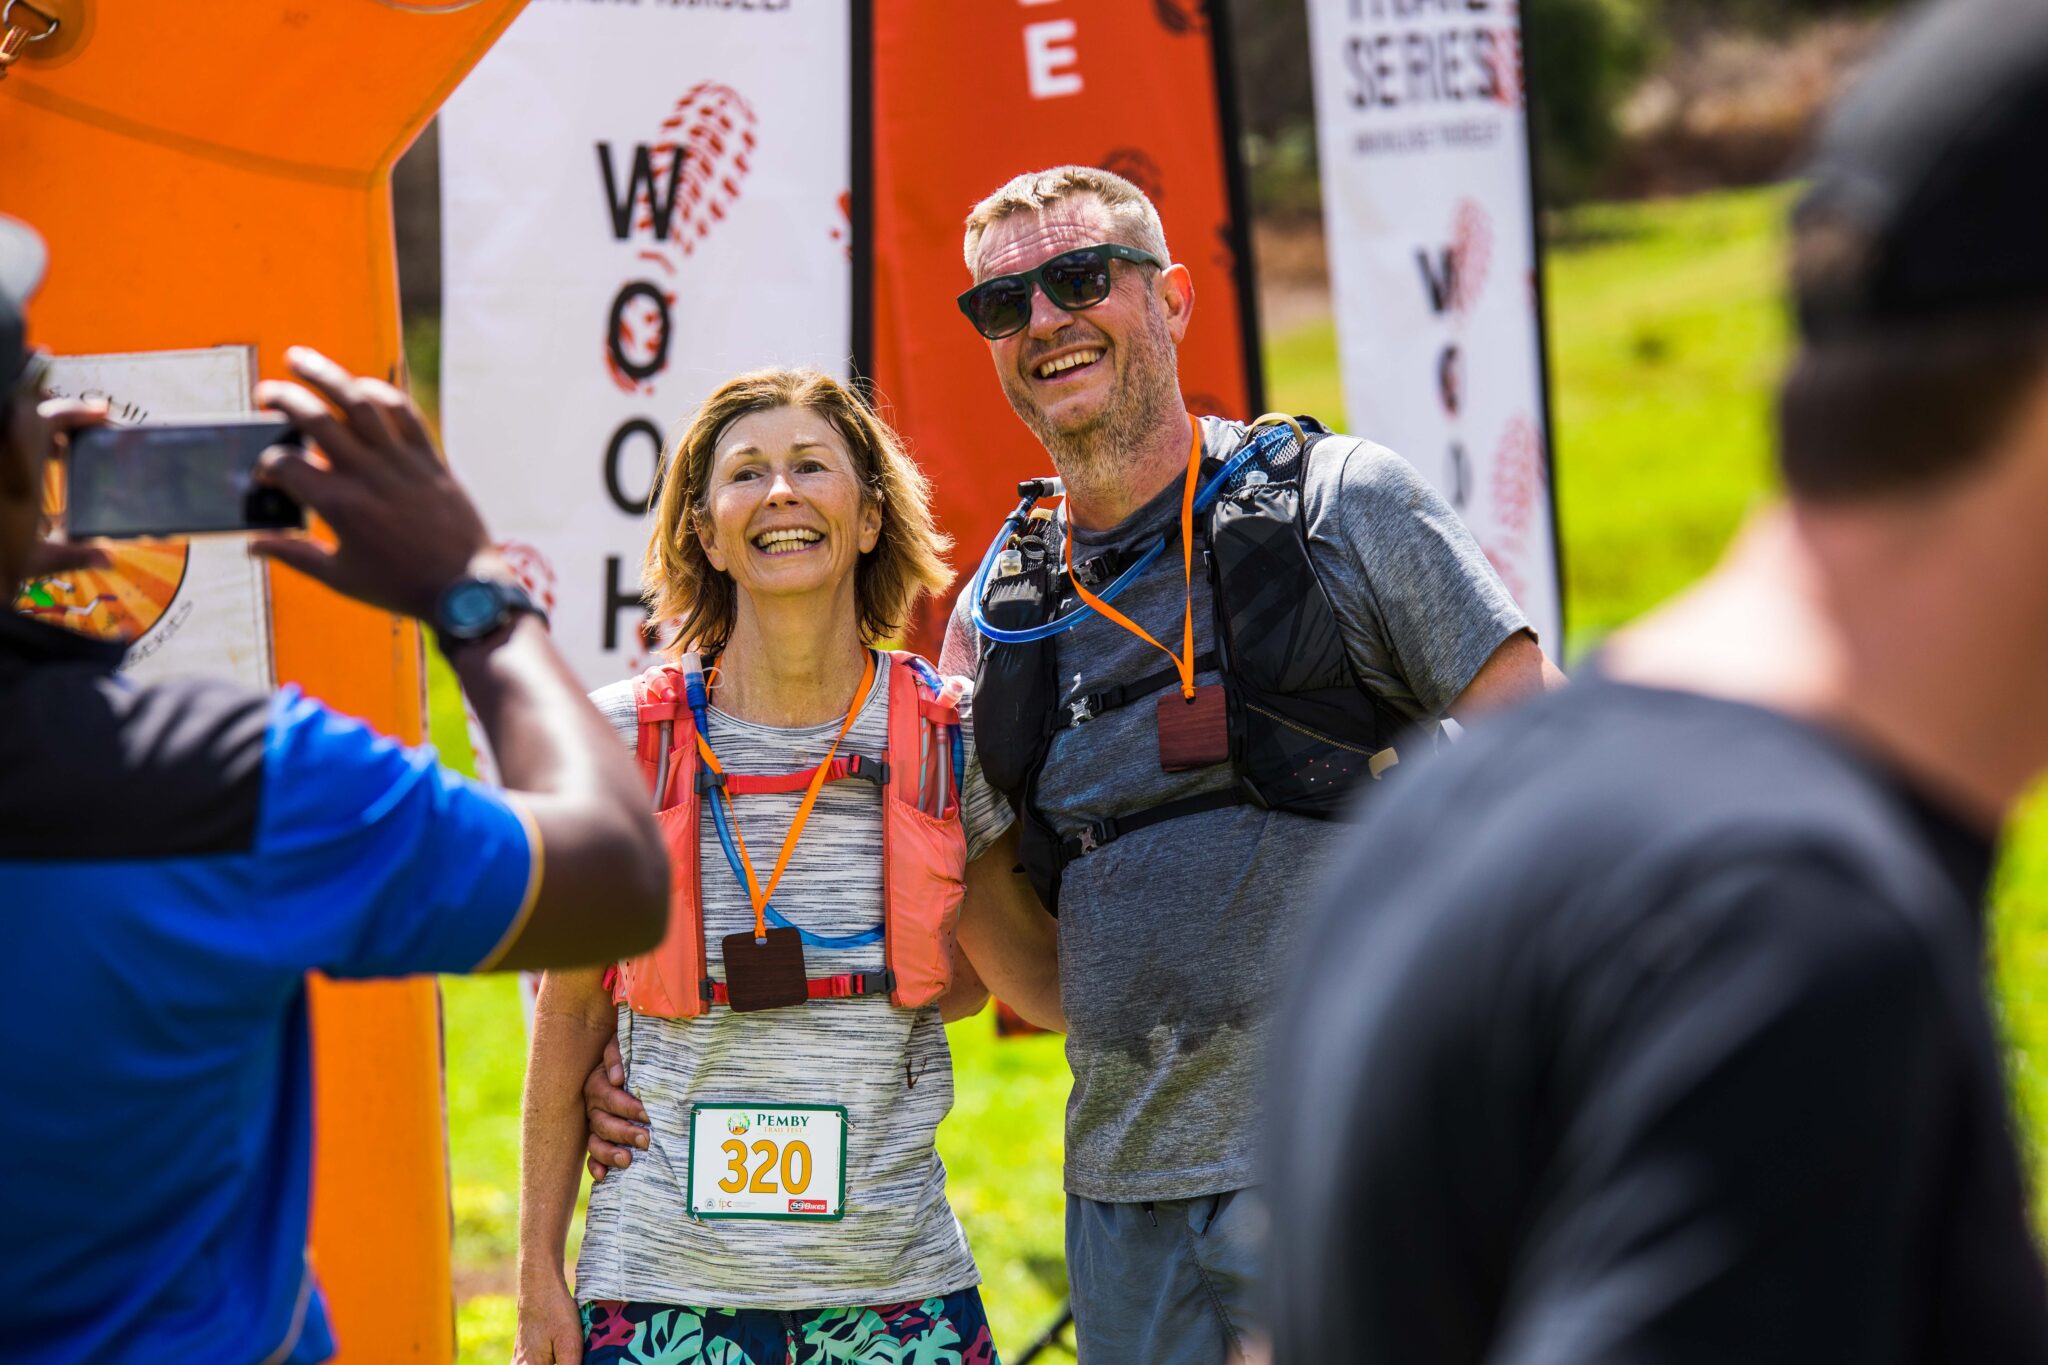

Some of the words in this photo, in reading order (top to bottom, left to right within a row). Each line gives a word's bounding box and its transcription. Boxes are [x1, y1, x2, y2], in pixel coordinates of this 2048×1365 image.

[1022, 0, 1084, 99] E
[1346, 27, 1500, 108] SERIES
[1413, 243, 1471, 507] WOO
[757, 1113, 810, 1127] PEMBY
[786, 1126, 803, 1134] FEST
[718, 1139, 813, 1195] 320
